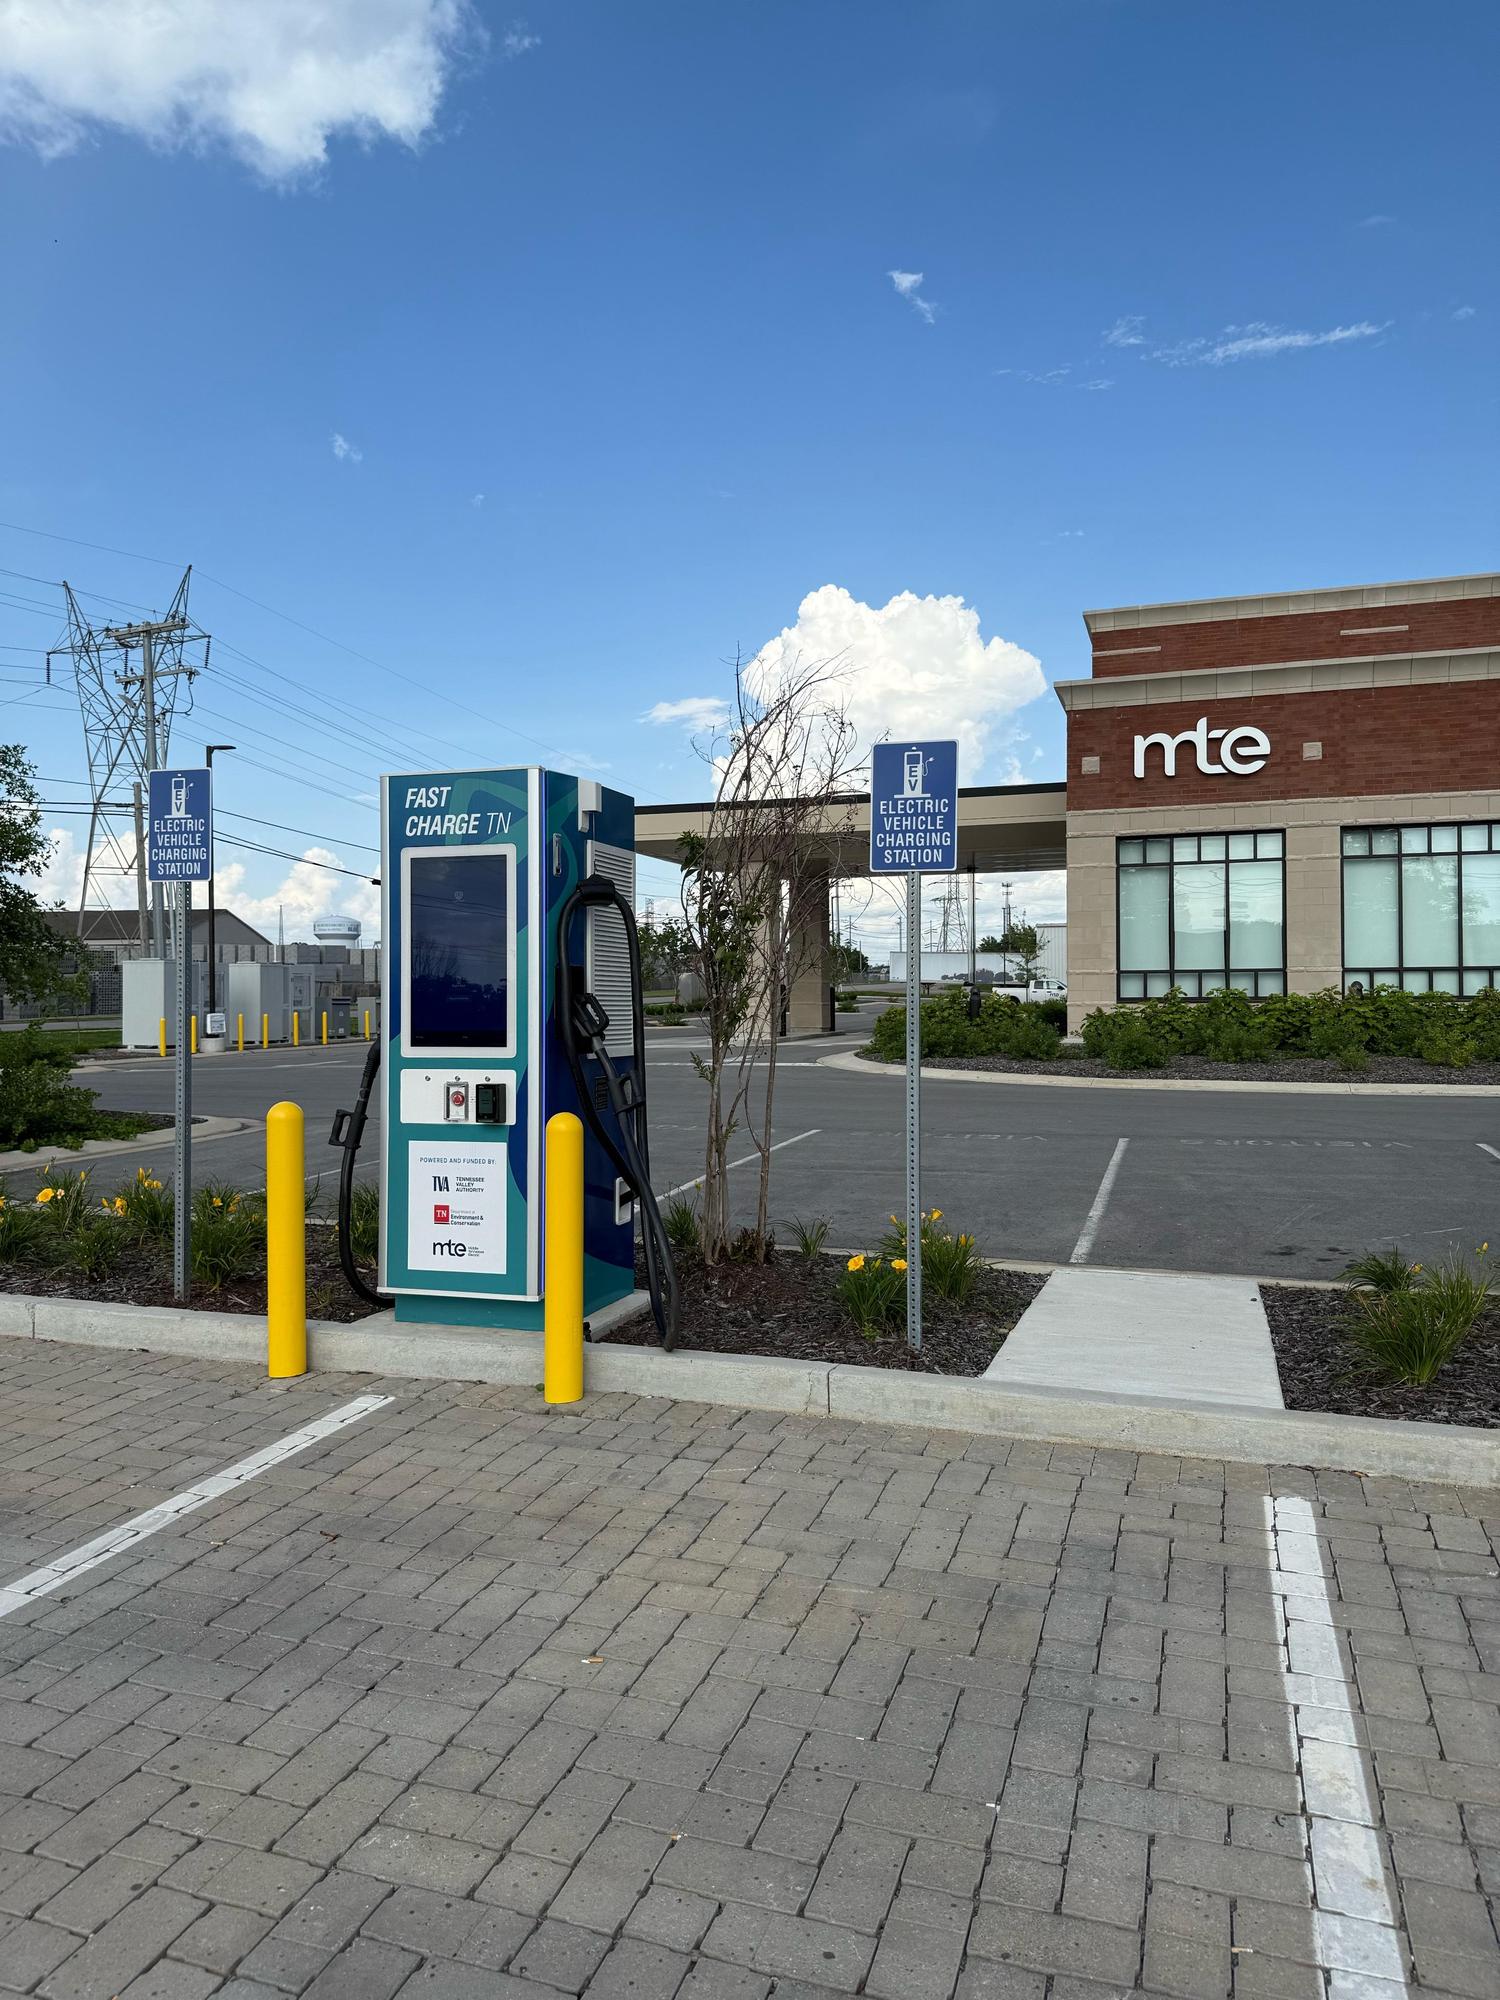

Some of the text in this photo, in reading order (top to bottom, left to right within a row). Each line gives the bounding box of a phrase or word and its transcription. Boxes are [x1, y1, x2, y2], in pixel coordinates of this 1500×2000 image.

[1133, 716, 1271, 779] mte
[405, 786, 452, 809] FAST
[880, 798, 949, 815] ELECTRIC
[154, 819, 205, 832] ELECTRIC
[405, 811, 512, 837] CHARGE TN
[883, 815, 944, 831] VEHICLE
[157, 833, 202, 846] VEHICLE
[876, 832, 951, 848] CHARGING
[151, 847, 207, 861] CHARGING
[884, 848, 943, 864] STATION
[157, 862, 201, 875] STATION
[432, 1175, 450, 1192] TVA
[436, 1209, 447, 1218] TN
[432, 1239, 467, 1258] mte
